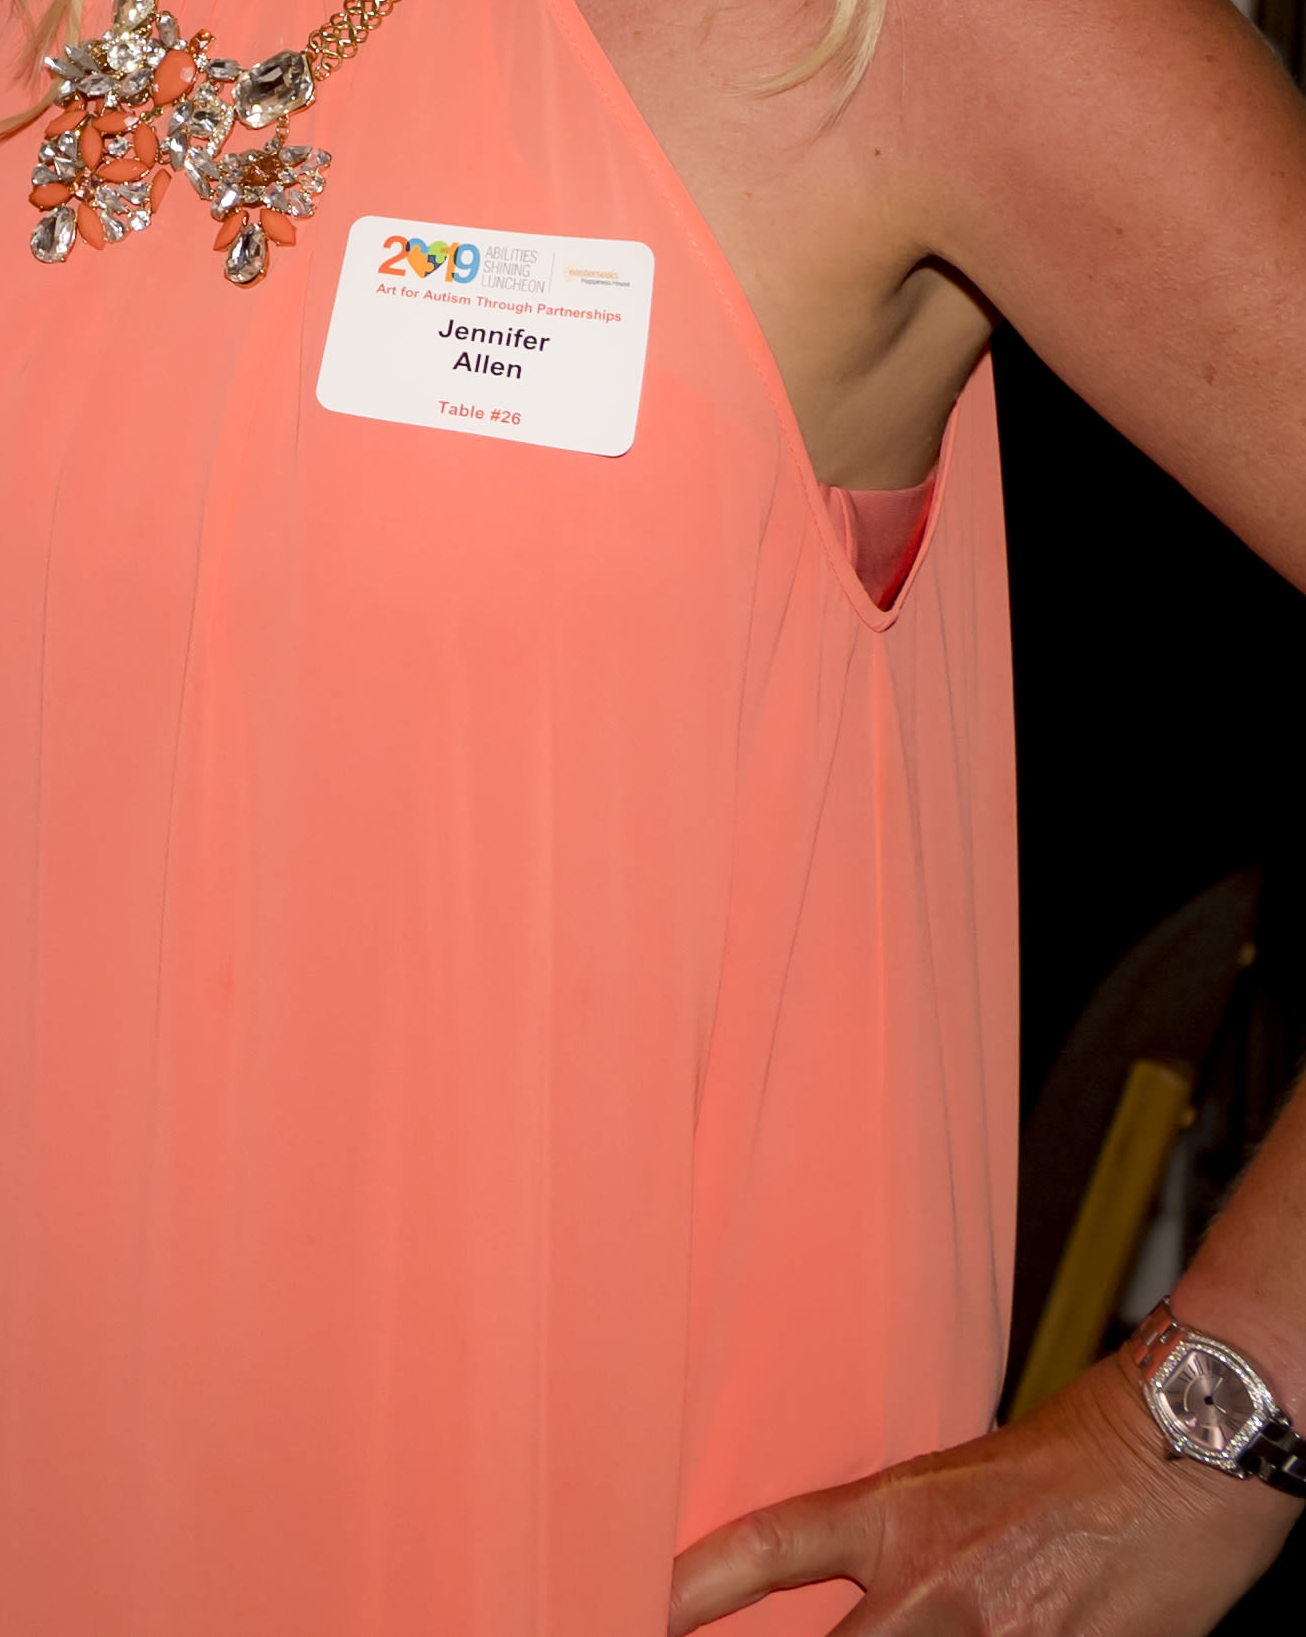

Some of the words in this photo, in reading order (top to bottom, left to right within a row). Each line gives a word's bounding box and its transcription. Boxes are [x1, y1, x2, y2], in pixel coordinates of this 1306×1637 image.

[485, 246, 538, 263] ABILITIES
[483, 260, 531, 277] SHINING
[481, 274, 545, 294] LUNCHEON
[376, 283, 397, 295] Art
[401, 286, 420, 298] for
[423, 289, 471, 305] Autism
[477, 296, 532, 314] Through
[536, 303, 622, 323] Partnerships
[438, 319, 550, 351] Jennifer
[452, 351, 522, 379] Allen
[438, 400, 485, 420] Table
[490, 408, 522, 425] #26
